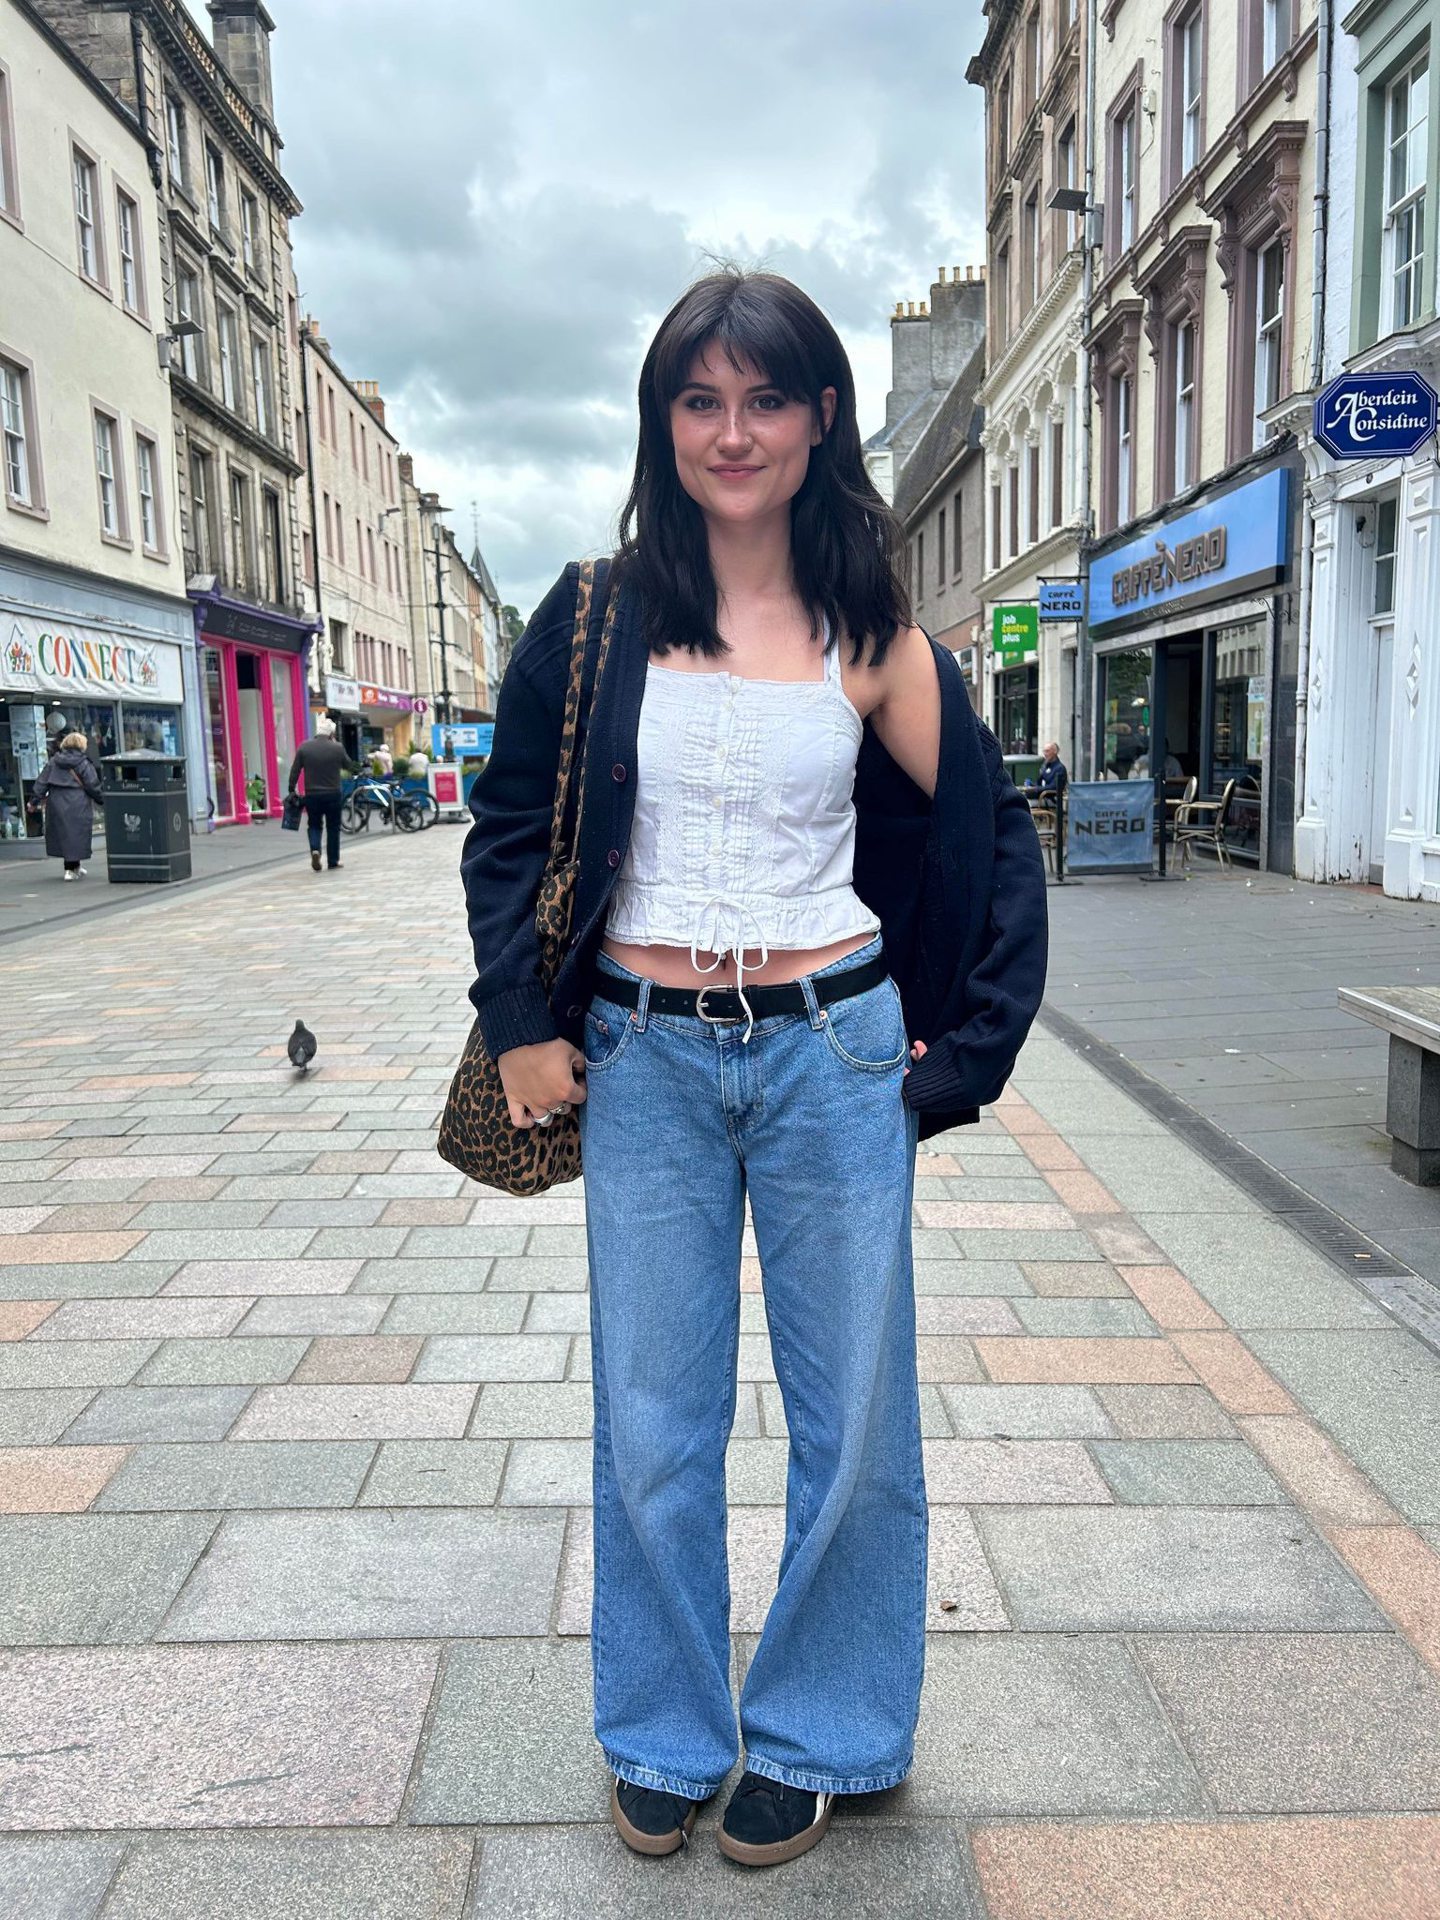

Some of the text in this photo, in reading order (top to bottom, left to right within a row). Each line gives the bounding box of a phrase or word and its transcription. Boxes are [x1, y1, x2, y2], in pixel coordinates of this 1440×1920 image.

[1326, 388, 1418, 428] Aberdein
[1349, 407, 1428, 442] Considine
[1164, 524, 1228, 588] NERO
[1041, 602, 1081, 611] NERO
[1001, 624, 1029, 634] centre
[1002, 615, 1017, 625] job
[1002, 633, 1020, 645] plus
[38, 633, 136, 684] CONNECT
[1074, 818, 1145, 836] NERO
